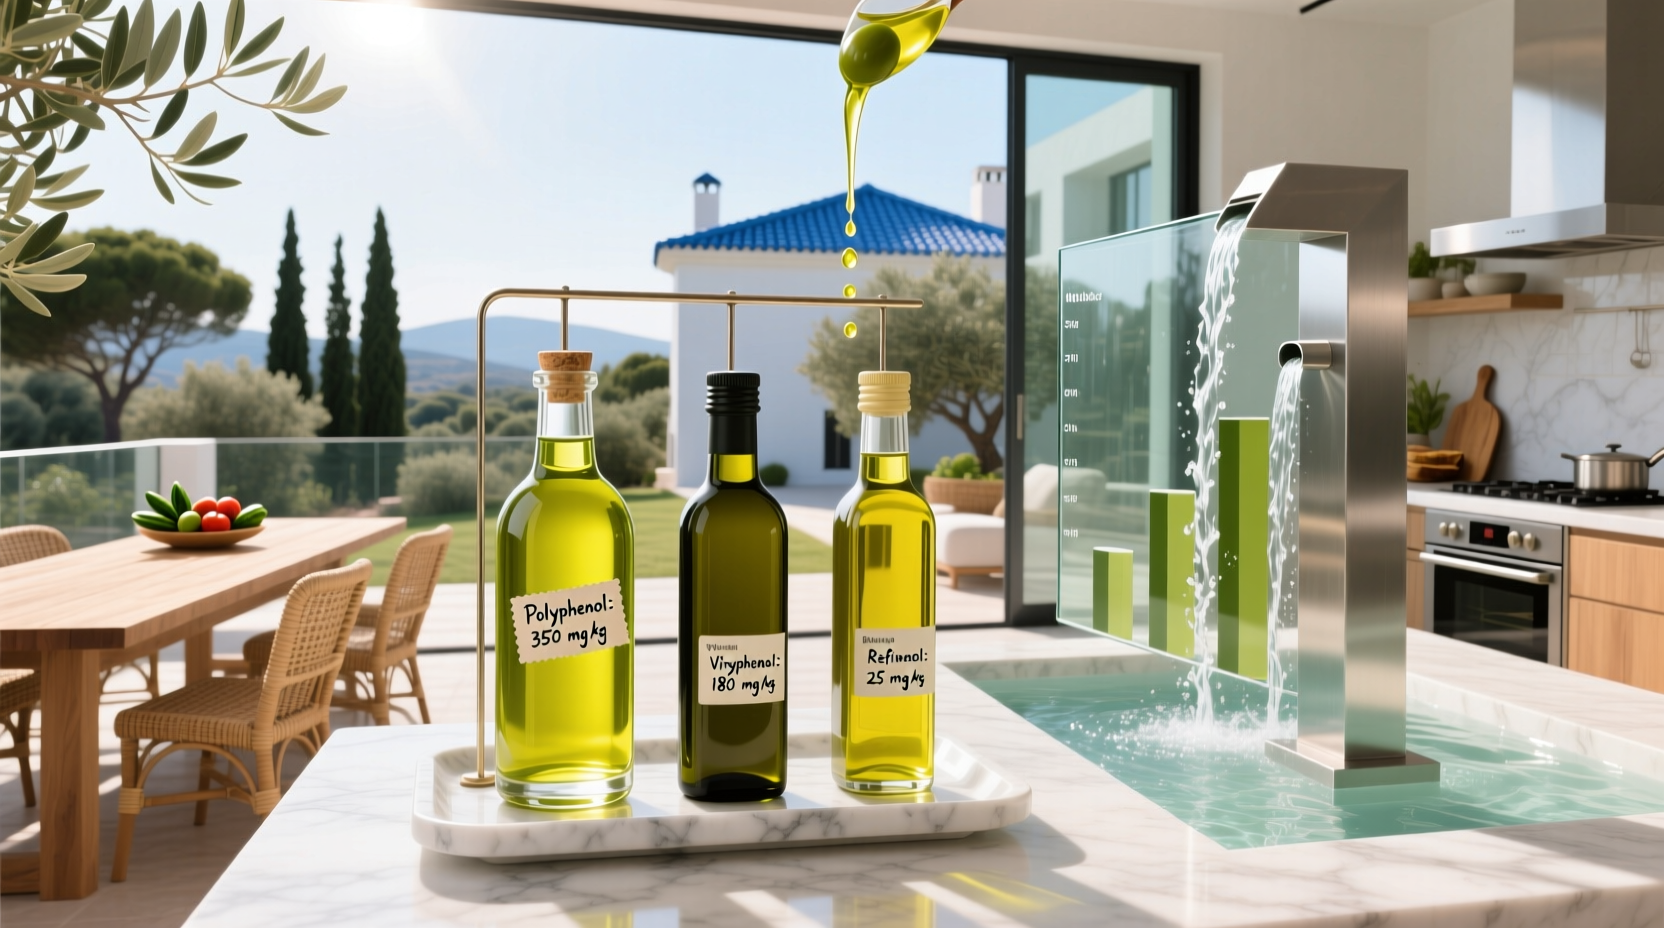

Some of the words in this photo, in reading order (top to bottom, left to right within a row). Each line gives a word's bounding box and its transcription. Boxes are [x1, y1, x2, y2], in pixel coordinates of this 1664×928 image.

[523, 593, 614, 628] Polyphenol:
[531, 629, 561, 649] 350
[712, 675, 736, 692] 180
[866, 670, 886, 685] 25
